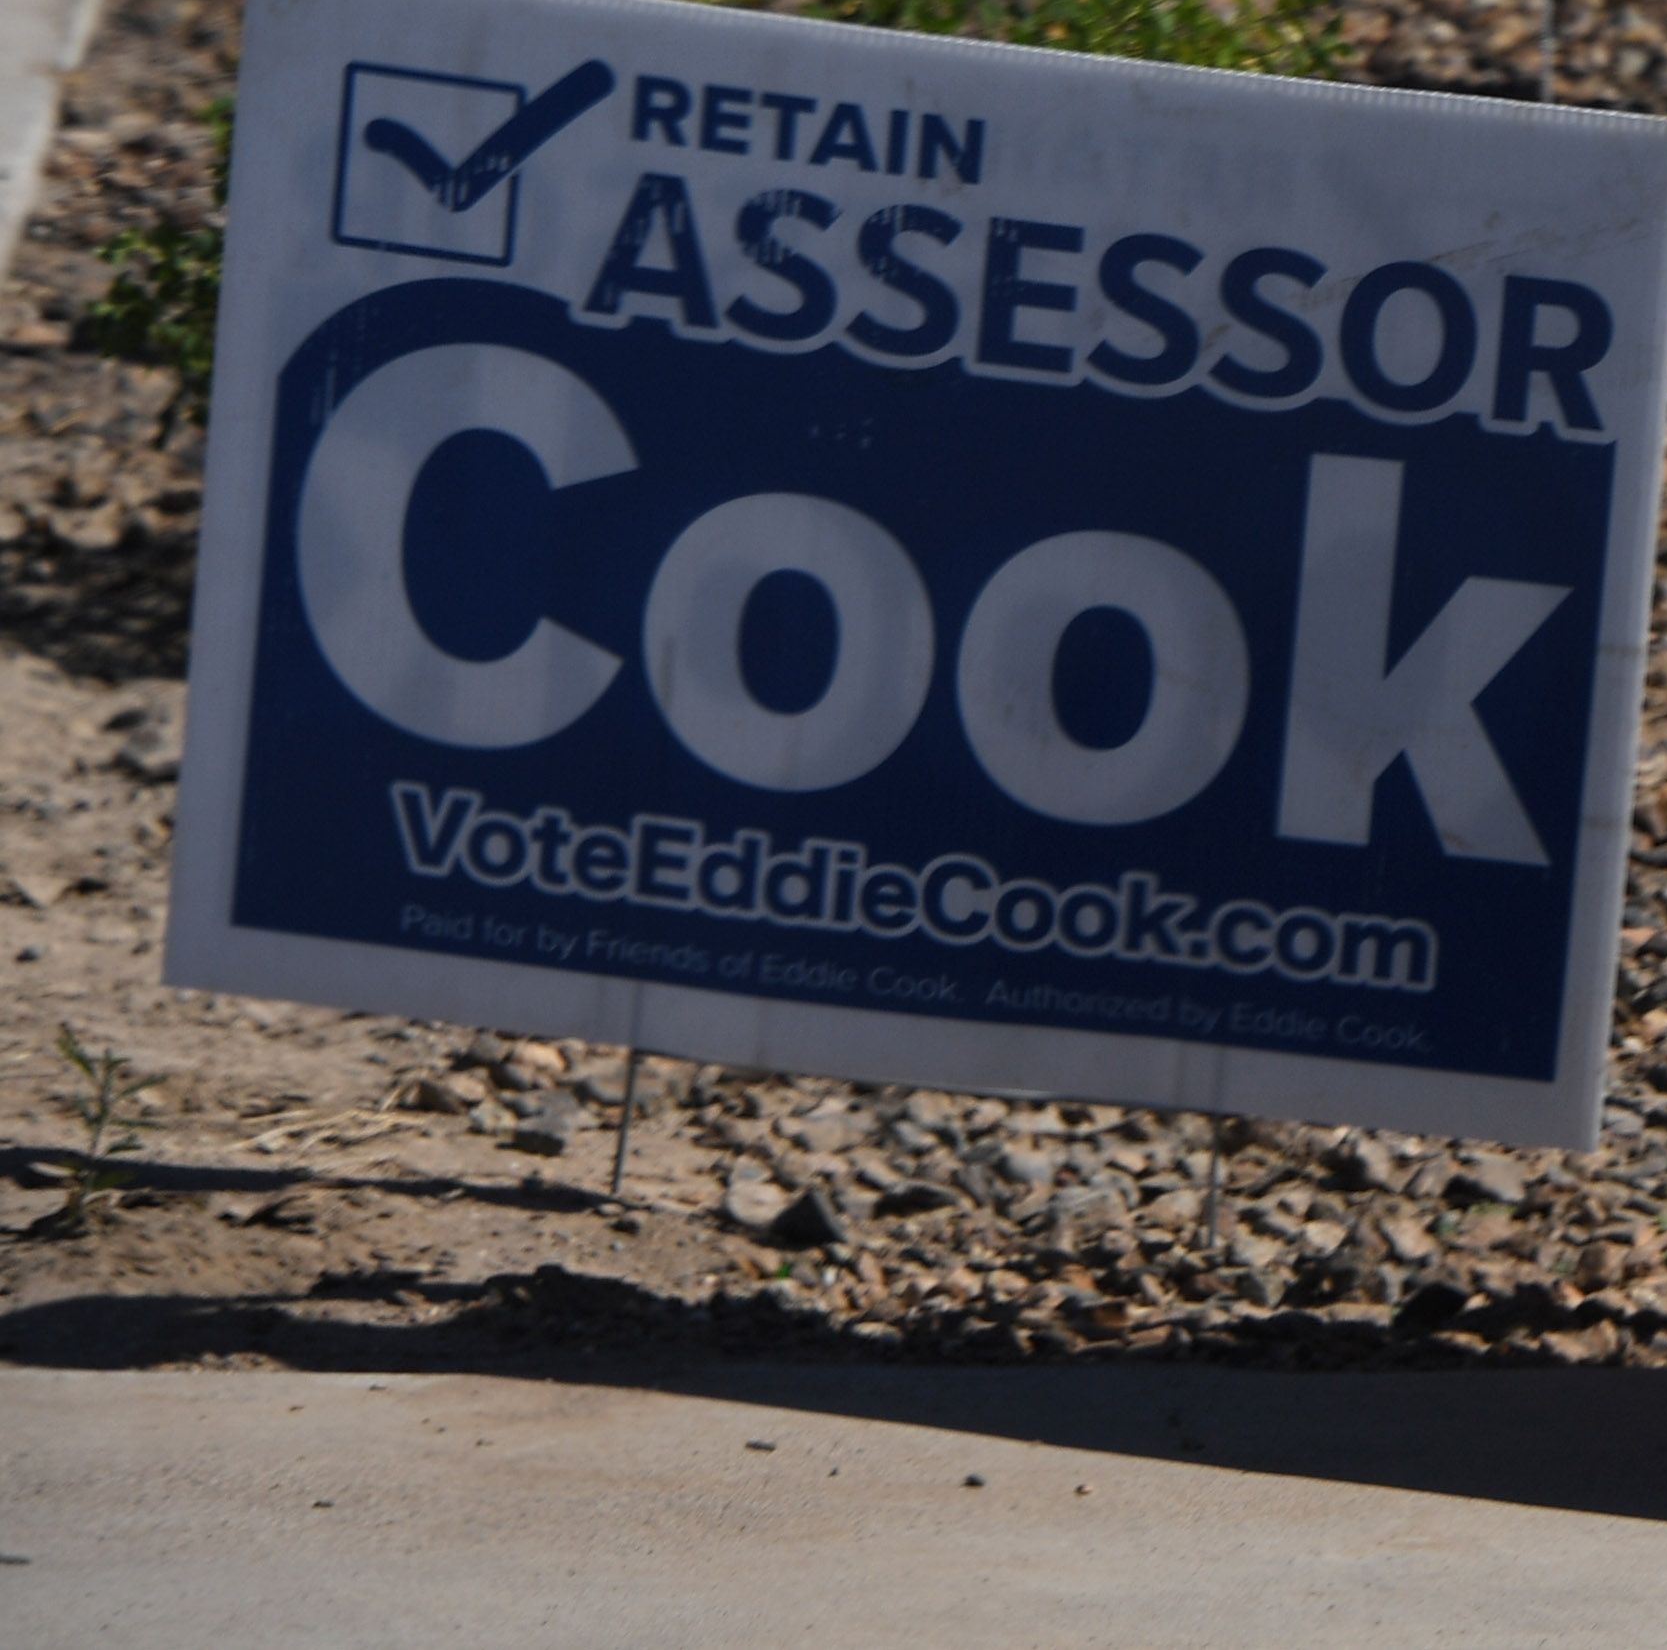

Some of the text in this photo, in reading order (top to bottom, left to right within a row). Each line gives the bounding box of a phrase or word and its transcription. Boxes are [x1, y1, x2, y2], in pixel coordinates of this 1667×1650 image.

[631, 75, 985, 185] RETAIN
[581, 173, 1615, 433] ASSESSOR
[297, 342, 1575, 867] Cook
[398, 788, 1434, 986] VoteEddieCook.com
[400, 901, 473, 942] Paid
[483, 914, 527, 950] for
[537, 922, 580, 961] by
[587, 928, 711, 974] Friends
[718, 948, 753, 979] of
[758, 953, 858, 991] Eddie
[985, 979, 1168, 1021] Authorized
[1179, 995, 1224, 1034] by
[1229, 1002, 1327, 1040] Eddie
